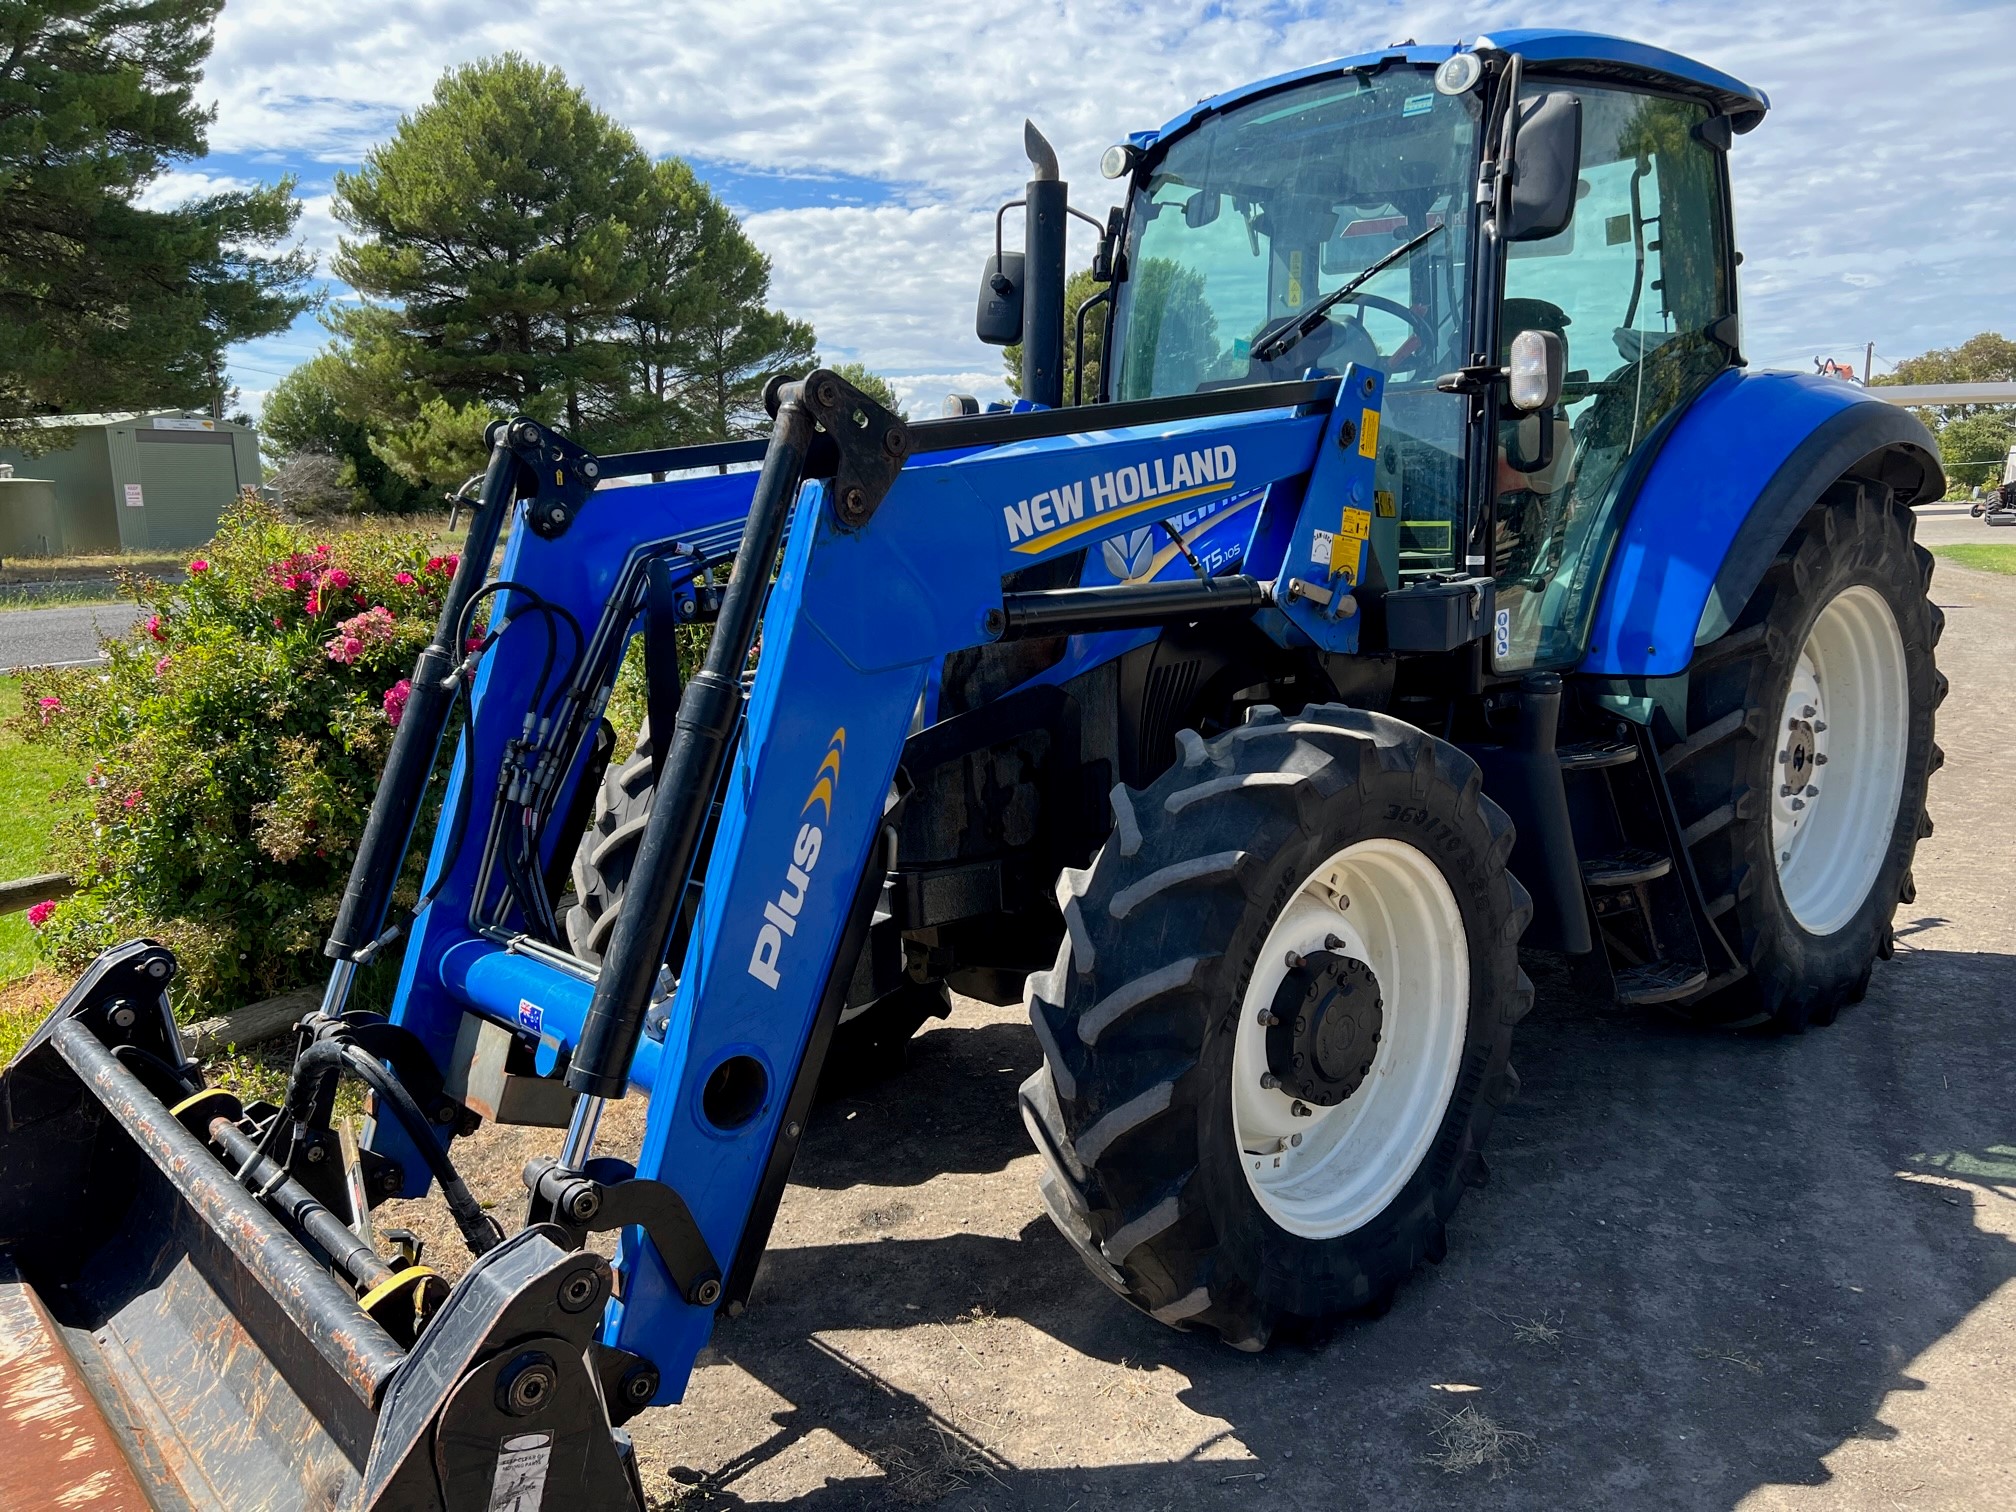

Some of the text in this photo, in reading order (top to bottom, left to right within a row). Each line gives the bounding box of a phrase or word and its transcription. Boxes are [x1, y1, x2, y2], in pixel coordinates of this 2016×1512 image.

[1003, 444, 1237, 543] NEW HOLLAND
[747, 823, 823, 991] Plus
